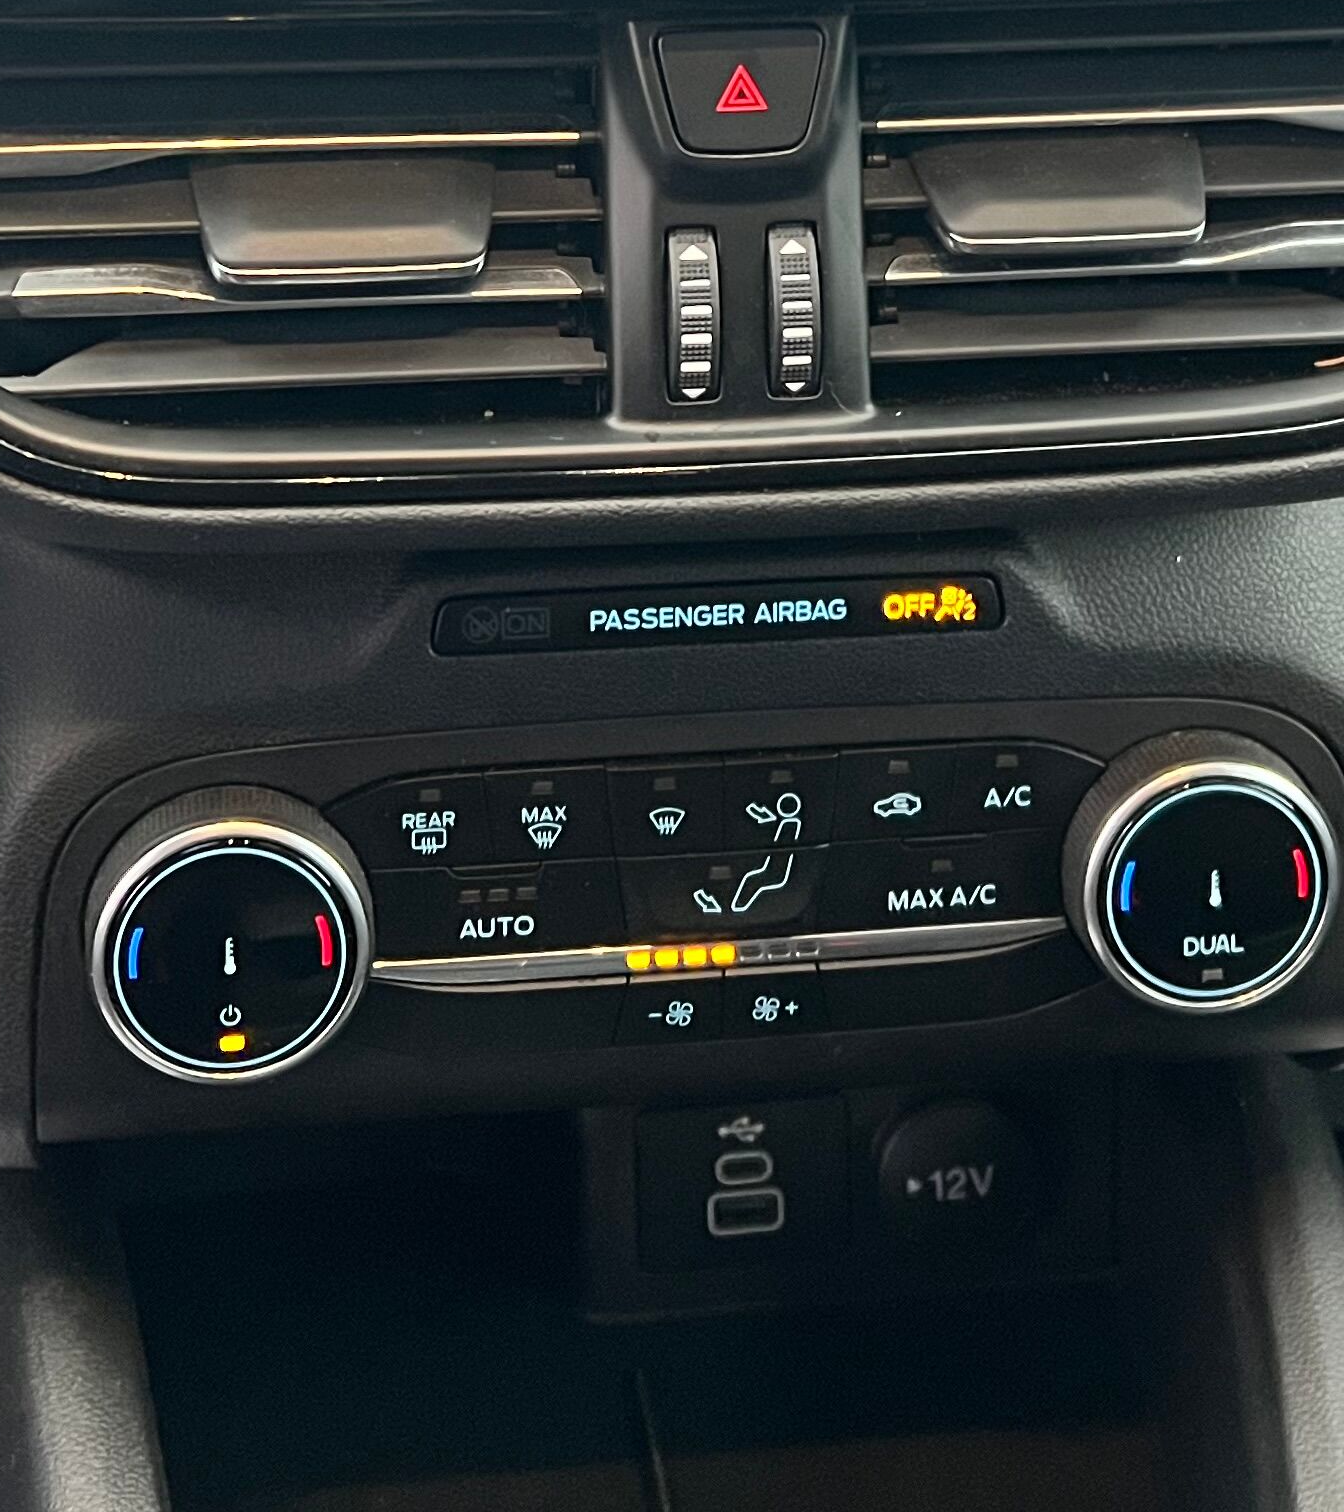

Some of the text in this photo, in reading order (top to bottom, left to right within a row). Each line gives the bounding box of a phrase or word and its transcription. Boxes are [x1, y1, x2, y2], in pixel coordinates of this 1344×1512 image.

[589, 598, 848, 631] PASSENGER AIRBAG
[882, 592, 935, 620] OFF
[984, 785, 1032, 809] A/C
[402, 810, 455, 830] REAR
[521, 806, 567, 824] MAX
[888, 883, 997, 912] MAX A/C
[459, 915, 535, 939] AUTO
[1183, 934, 1244, 957] DUAL
[927, 1164, 994, 1201] 12V
